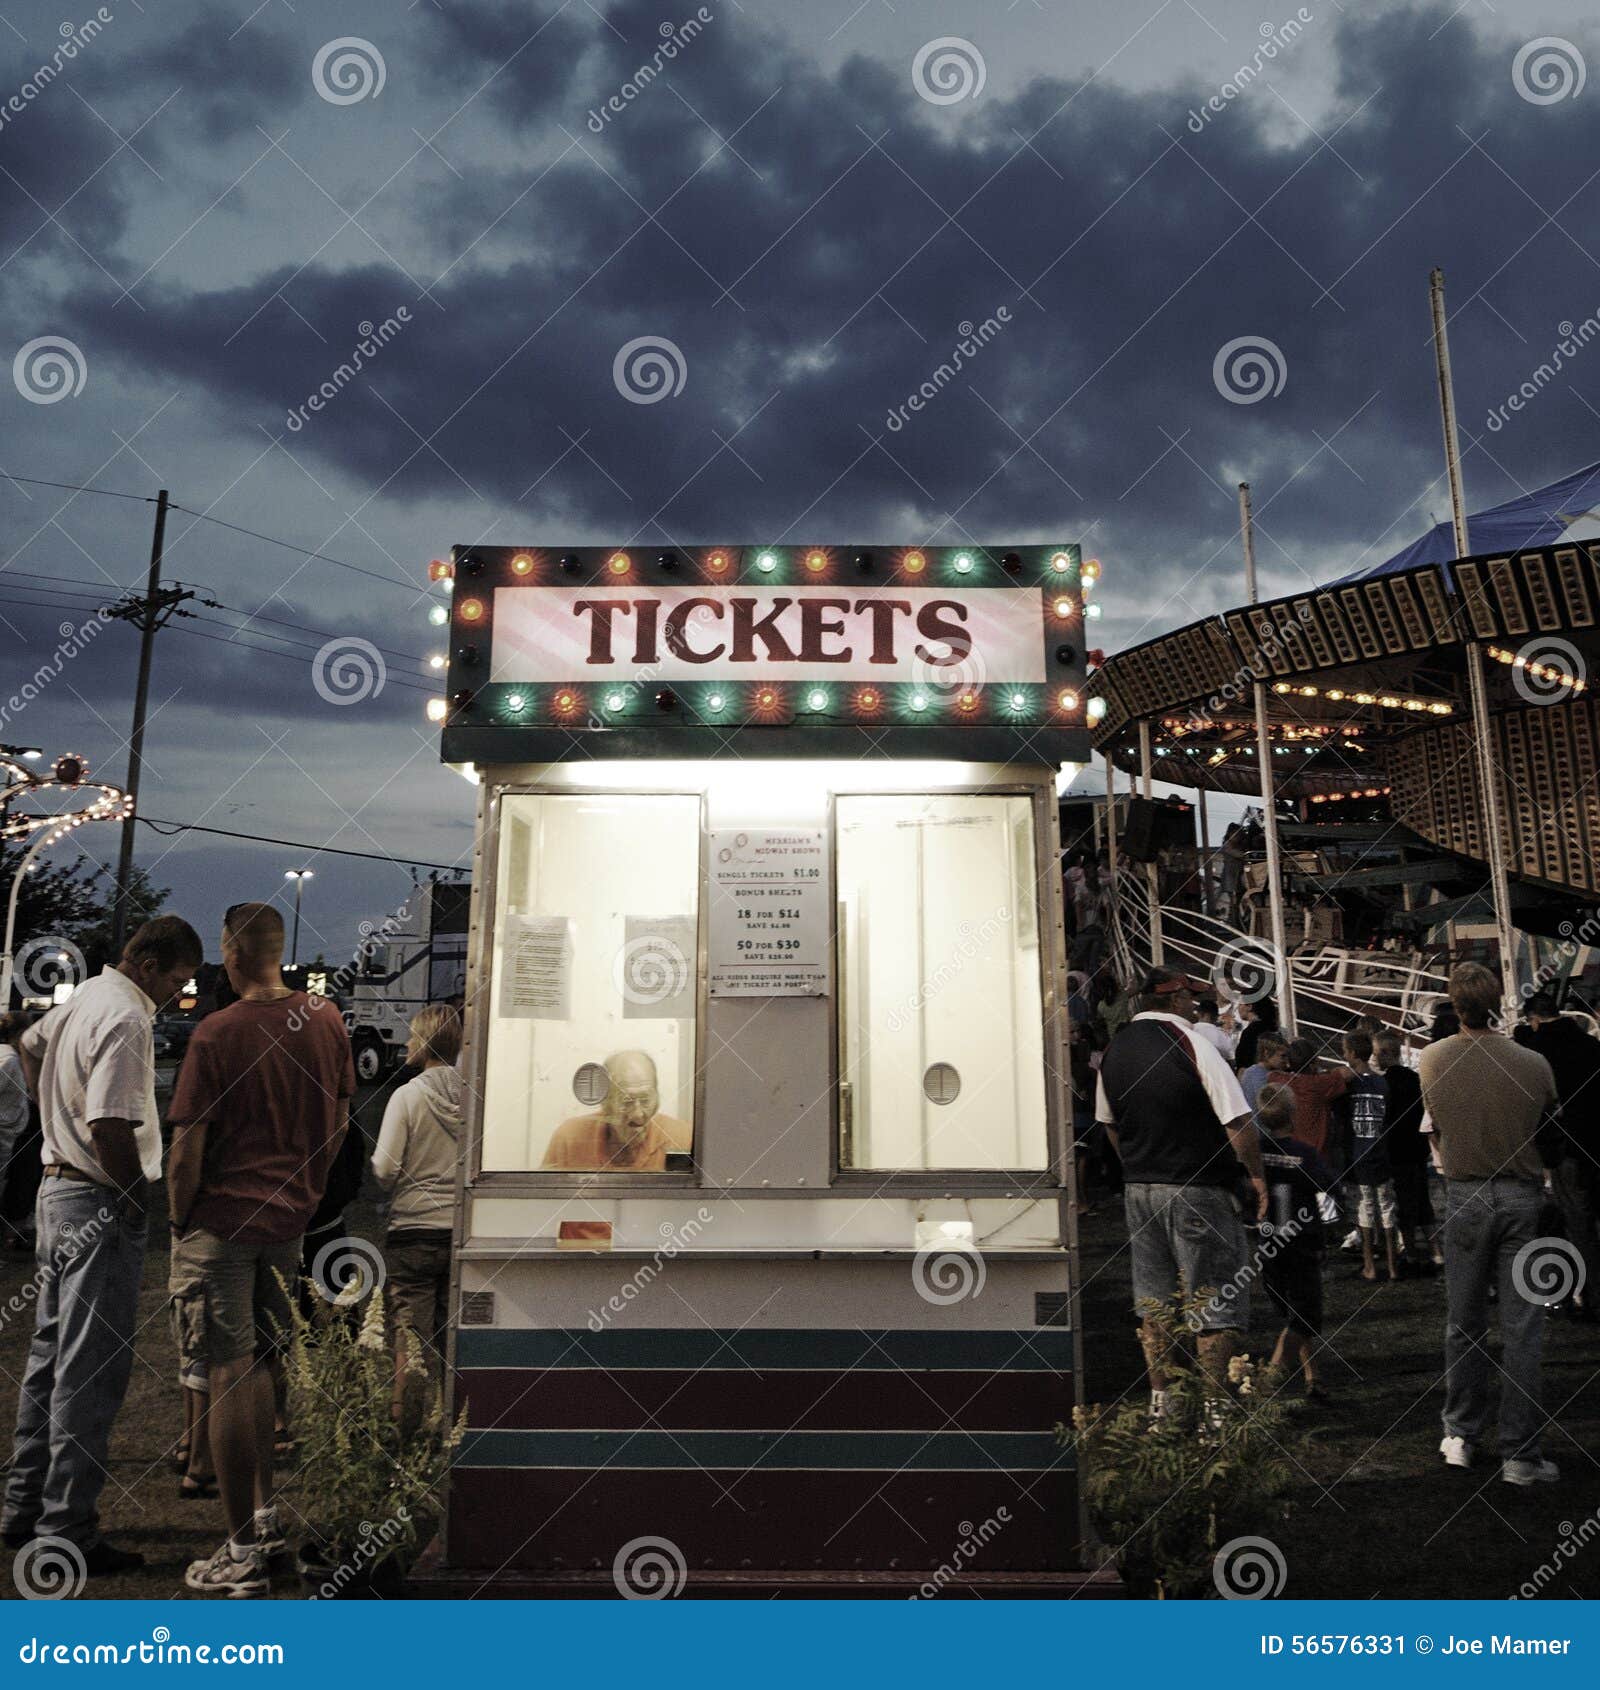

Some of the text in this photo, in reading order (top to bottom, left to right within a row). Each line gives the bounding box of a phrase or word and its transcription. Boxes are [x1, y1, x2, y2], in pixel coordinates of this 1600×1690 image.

[573, 597, 973, 667] TICKETS
[793, 868, 819, 877] $1.00
[737, 909, 751, 918] 18
[778, 909, 800, 919] $14
[737, 940, 752, 950] 50
[776, 940, 800, 949] $30
